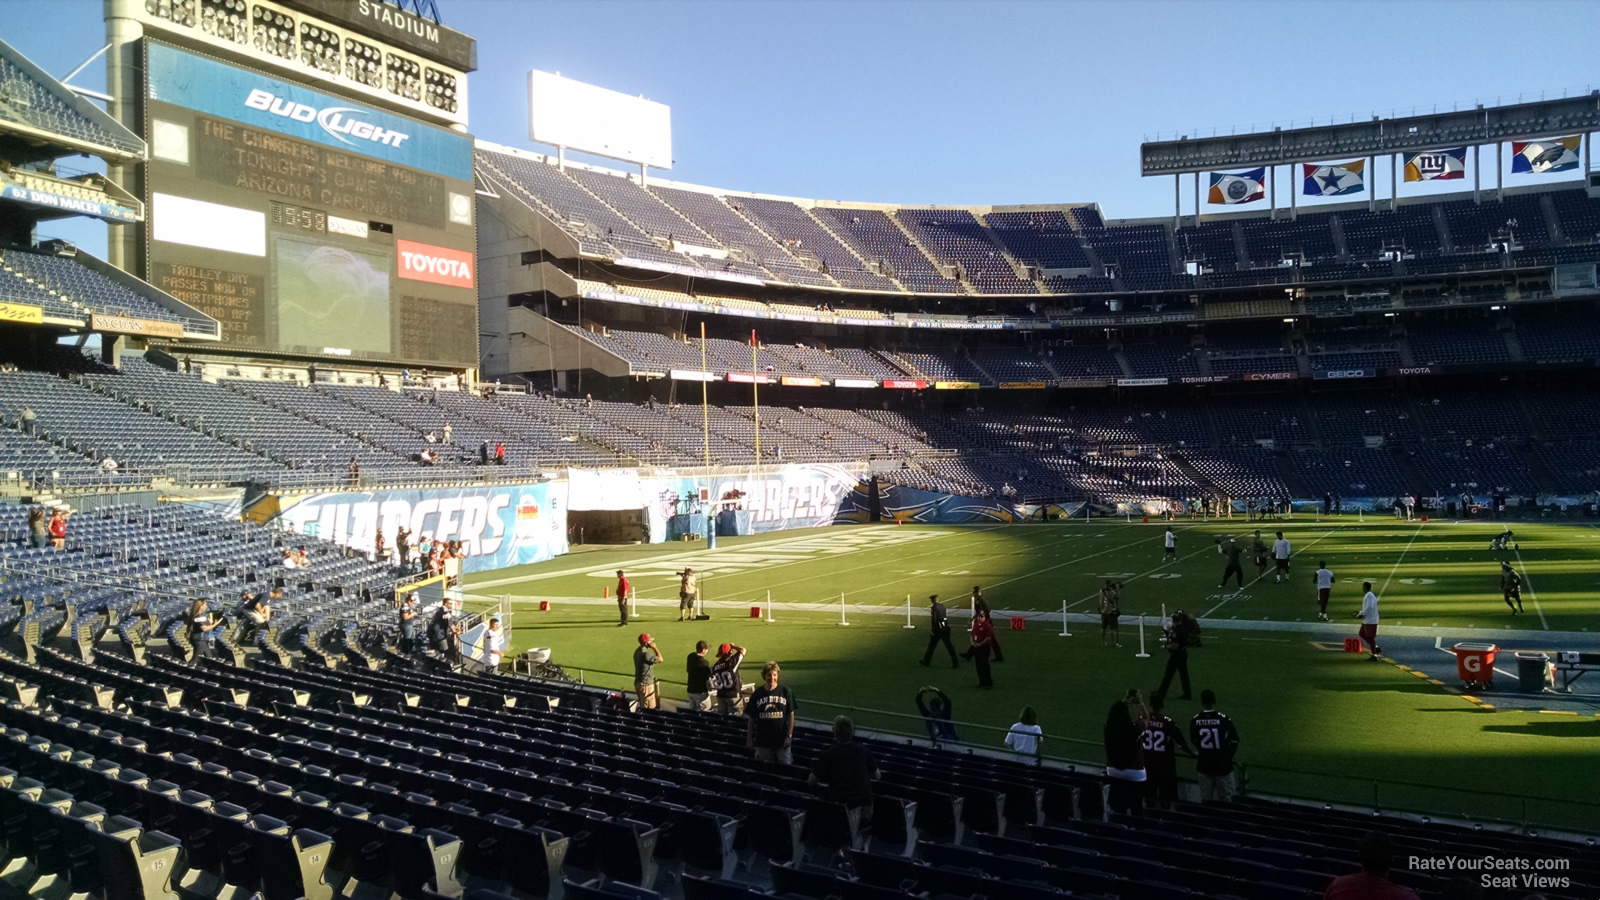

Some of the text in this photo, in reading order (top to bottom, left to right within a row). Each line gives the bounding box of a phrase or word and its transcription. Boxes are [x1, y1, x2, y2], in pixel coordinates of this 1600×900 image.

[359, 0, 440, 44] STADIUM
[245, 88, 409, 147] BUD LIGHT
[202, 119, 234, 140] THE
[242, 129, 320, 162] CHARGERS
[235, 170, 313, 200] ARIZONA
[12, 188, 28, 199] 62
[30, 191, 59, 206] DON
[60, 197, 102, 214] MACEK
[401, 251, 471, 280] TOYOTA
[170, 264, 249, 285] TROLLEY DAY
[162, 276, 207, 291] PASSES
[214, 283, 236, 295] NOW
[170, 290, 250, 309] SMARTPHONES
[95, 317, 143, 332] SYCUAN
[222, 320, 248, 332] CKET
[1251, 372, 1291, 381] CYMER
[1327, 369, 1364, 379] GEICO
[1398, 367, 1431, 375] TOYOTA
[893, 381, 916, 389] TOYOTA
[1181, 376, 1213, 384] TOSHIBA
[1012, 618, 1022, 629] 20
[1345, 638, 1359, 652] 30
[1463, 655, 1481, 672] G
[757, 695, 787, 707] SAN DIEGO
[1142, 730, 1166, 752] 32
[1199, 728, 1221, 750] 21
[153, 858, 164, 870] 15
[311, 854, 320, 864] 14
[440, 854, 450, 864] 13
